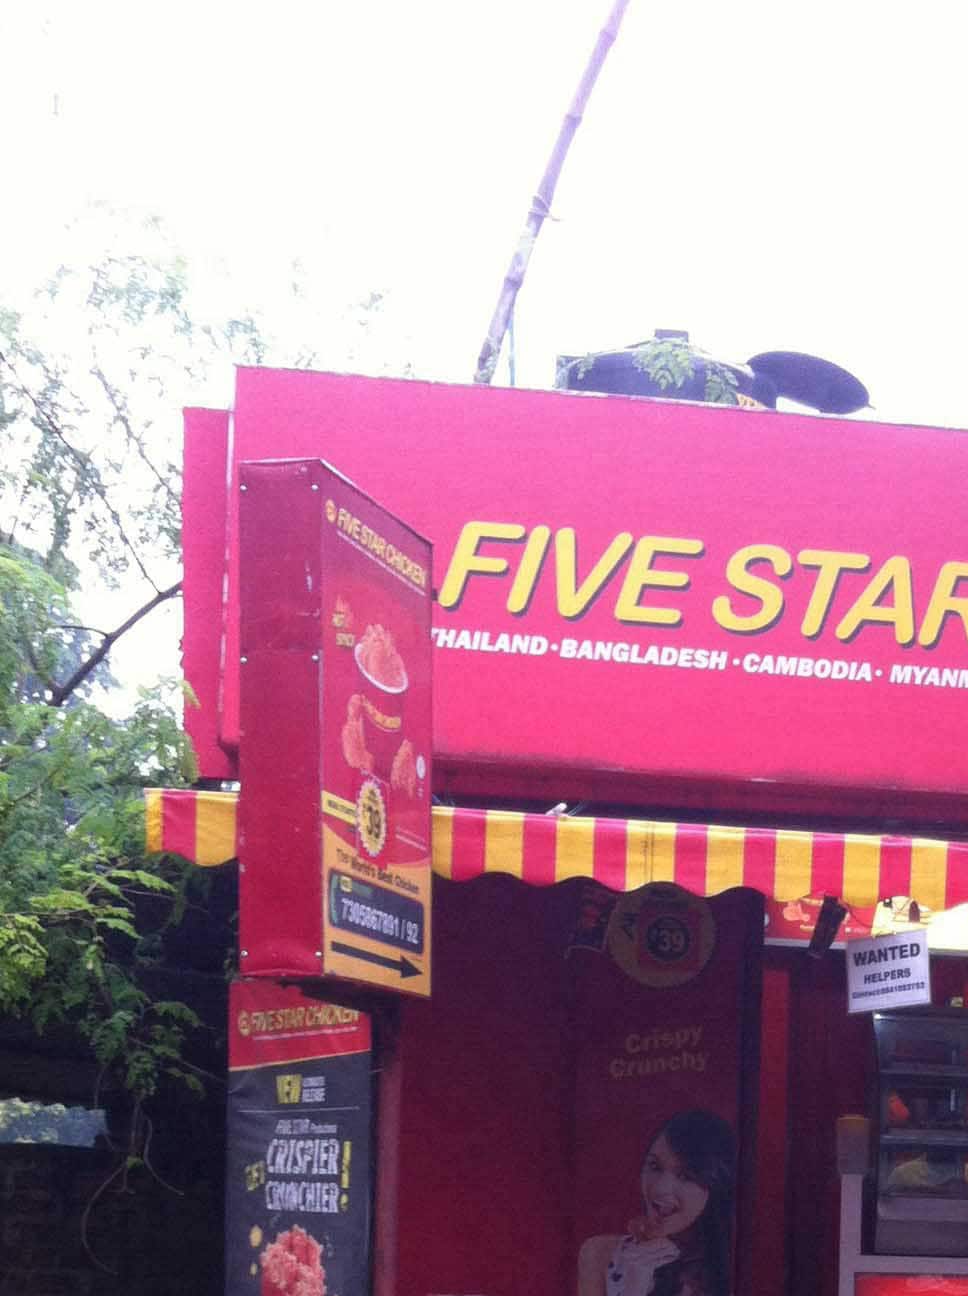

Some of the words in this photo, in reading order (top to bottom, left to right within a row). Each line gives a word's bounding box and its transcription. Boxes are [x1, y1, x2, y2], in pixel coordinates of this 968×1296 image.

[436, 520, 705, 627] FIVE
[560, 638, 728, 671] BANGLADESH
[743, 652, 873, 683] CAMBODIA
[853, 942, 921, 968] WANTED
[863, 967, 912, 985] HELPERS
[266, 1138, 340, 1175] CRISPIER
[264, 1180, 340, 1214] CRUNCHIER
